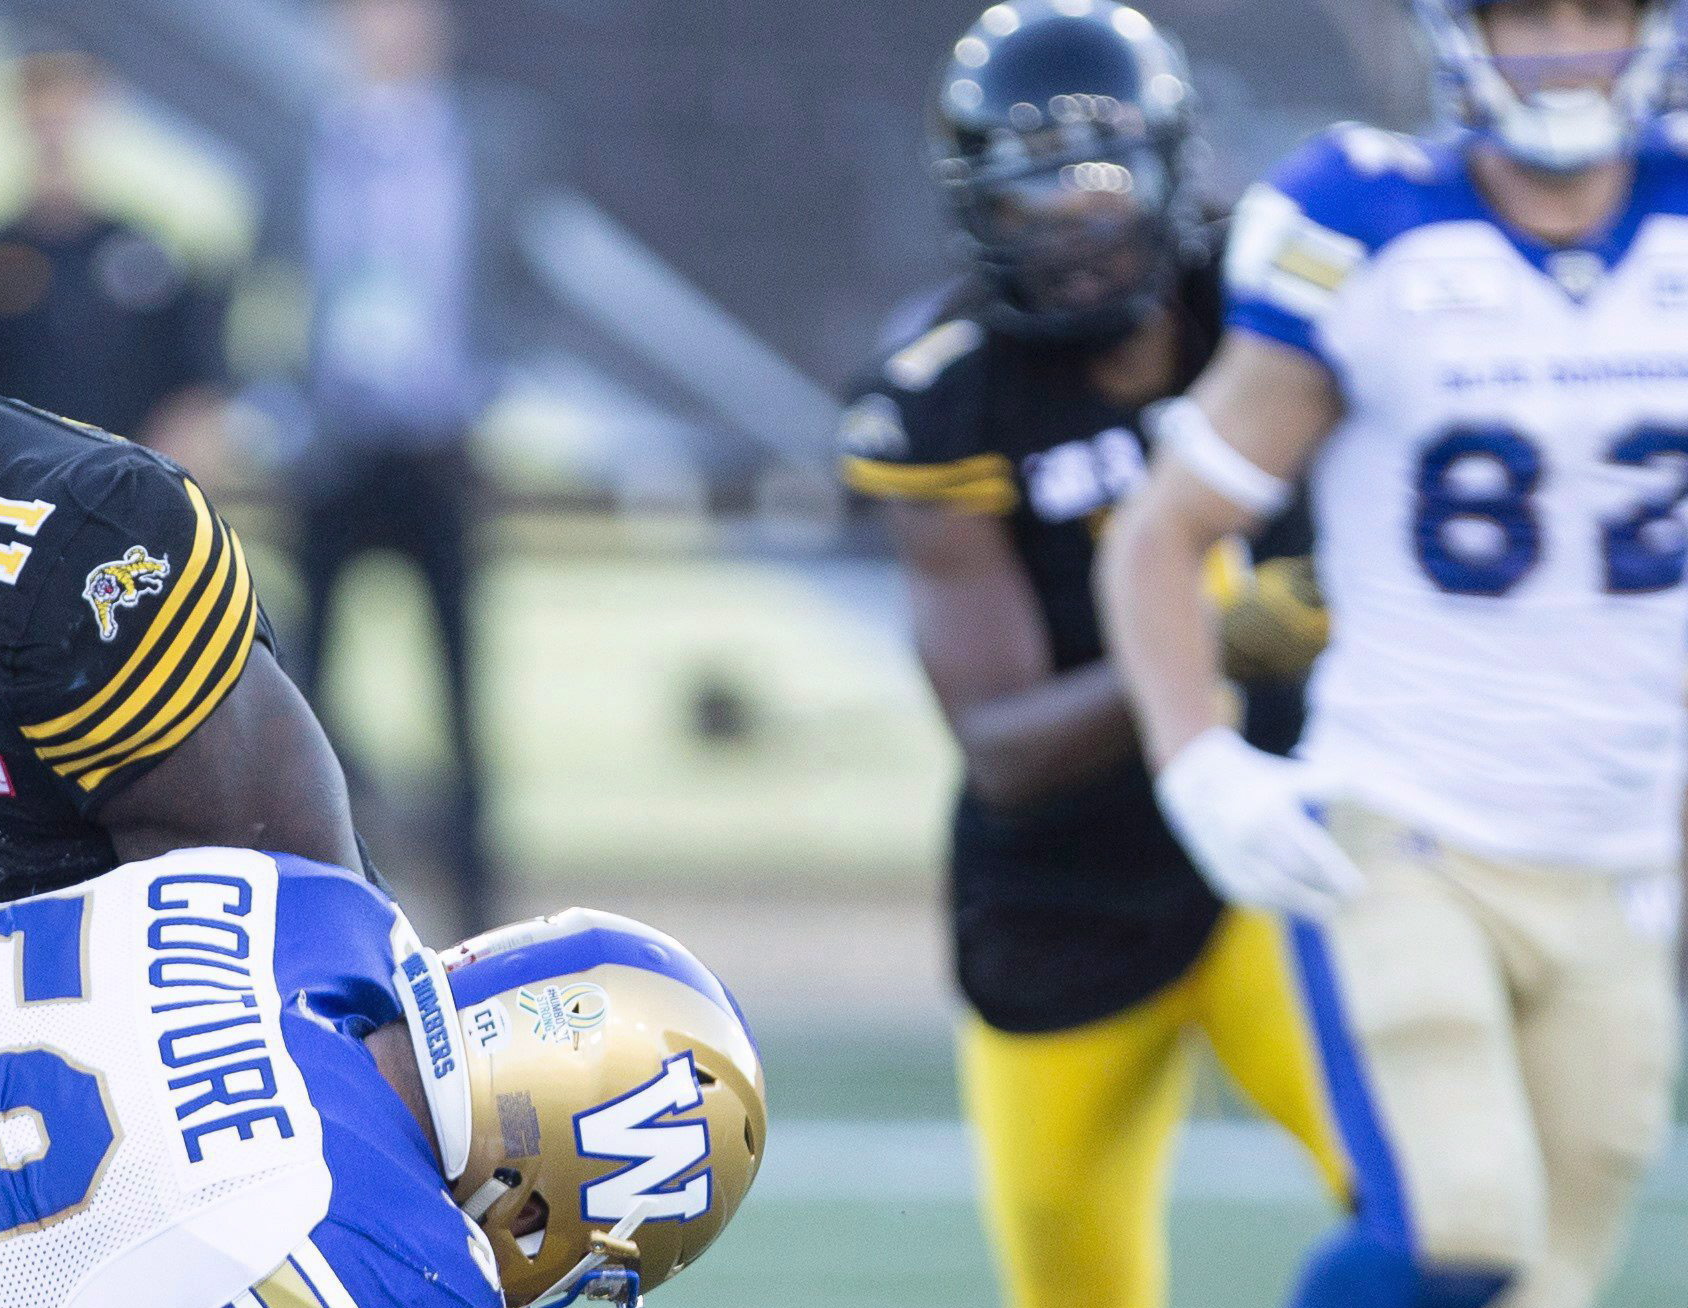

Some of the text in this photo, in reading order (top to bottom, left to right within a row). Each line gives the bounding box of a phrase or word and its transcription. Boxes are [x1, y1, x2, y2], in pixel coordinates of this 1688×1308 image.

[1415, 418, 1688, 598] 82
[148, 874, 295, 1163] COUTURE
[474, 1008, 498, 1047] CFL
[573, 1048, 712, 1225] W
